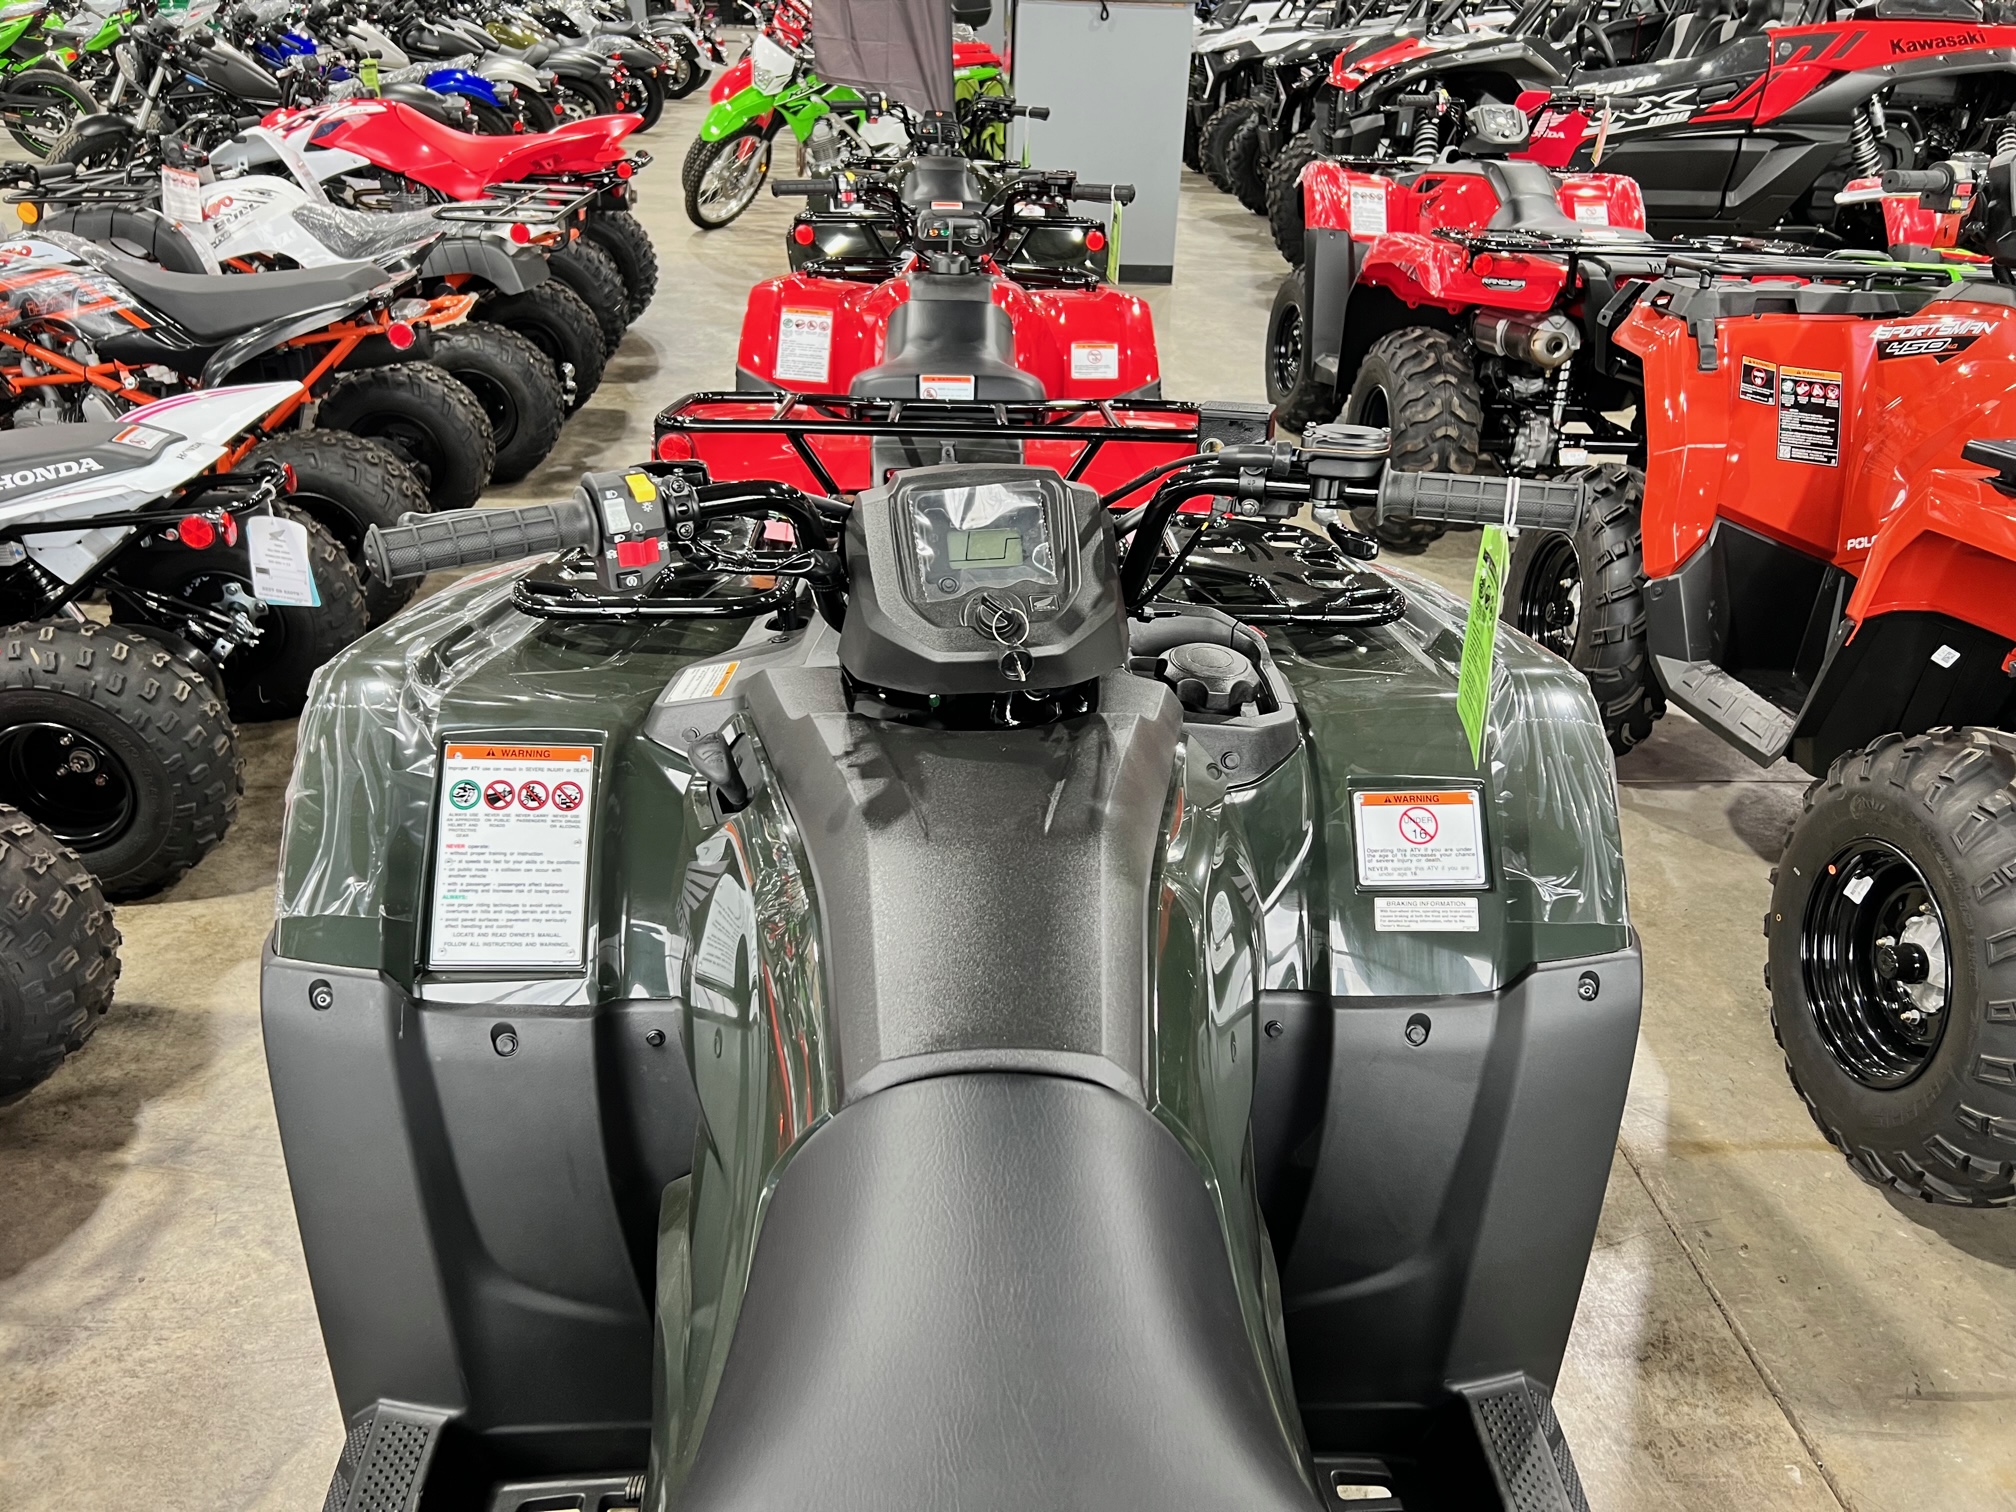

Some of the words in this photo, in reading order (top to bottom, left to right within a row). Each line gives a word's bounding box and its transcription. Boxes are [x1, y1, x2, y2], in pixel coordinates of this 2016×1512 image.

[1889, 30, 1986, 55] Kawasaki
[1647, 111, 1691, 125] 1000
[1482, 278, 1526, 287] RANCHER
[1870, 321, 1999, 338] SPORTSMAN
[1886, 338, 1952, 355] 450
[0, 458, 104, 491] HONDA
[501, 749, 550, 758] WARNING
[1394, 795, 1439, 803] WARNING
[1412, 829, 1427, 839] 16
